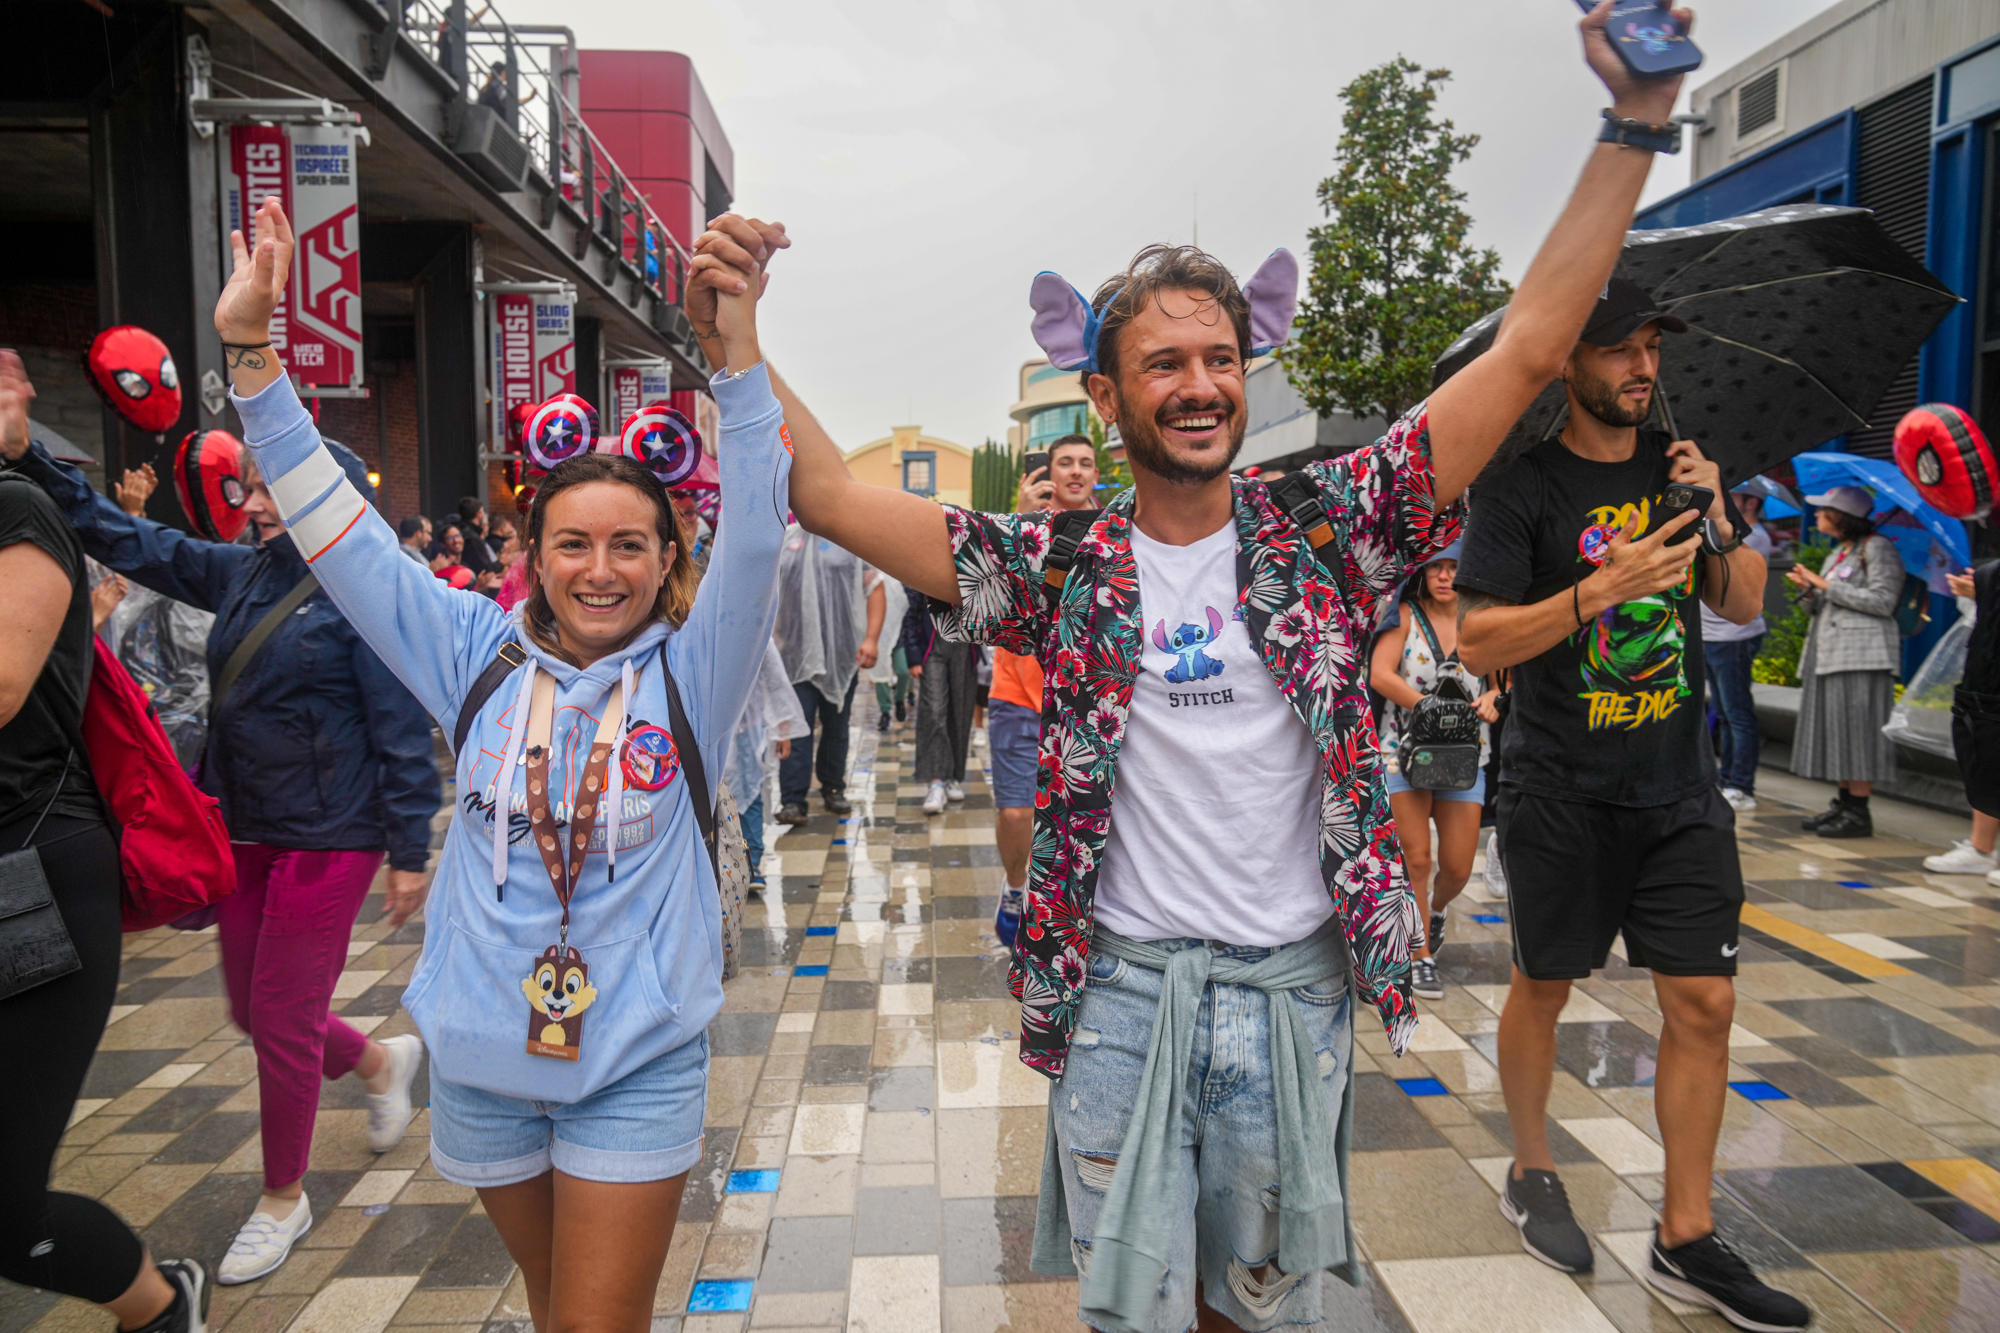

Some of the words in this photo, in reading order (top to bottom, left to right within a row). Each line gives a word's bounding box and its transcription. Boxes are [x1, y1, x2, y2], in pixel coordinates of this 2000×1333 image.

[296, 175, 350, 186] SPIDER-MAN
[537, 304, 569, 317] SLING
[505, 304, 531, 378] HOUSE
[295, 353, 324, 366] TECH
[1168, 688, 1235, 708] STITCH
